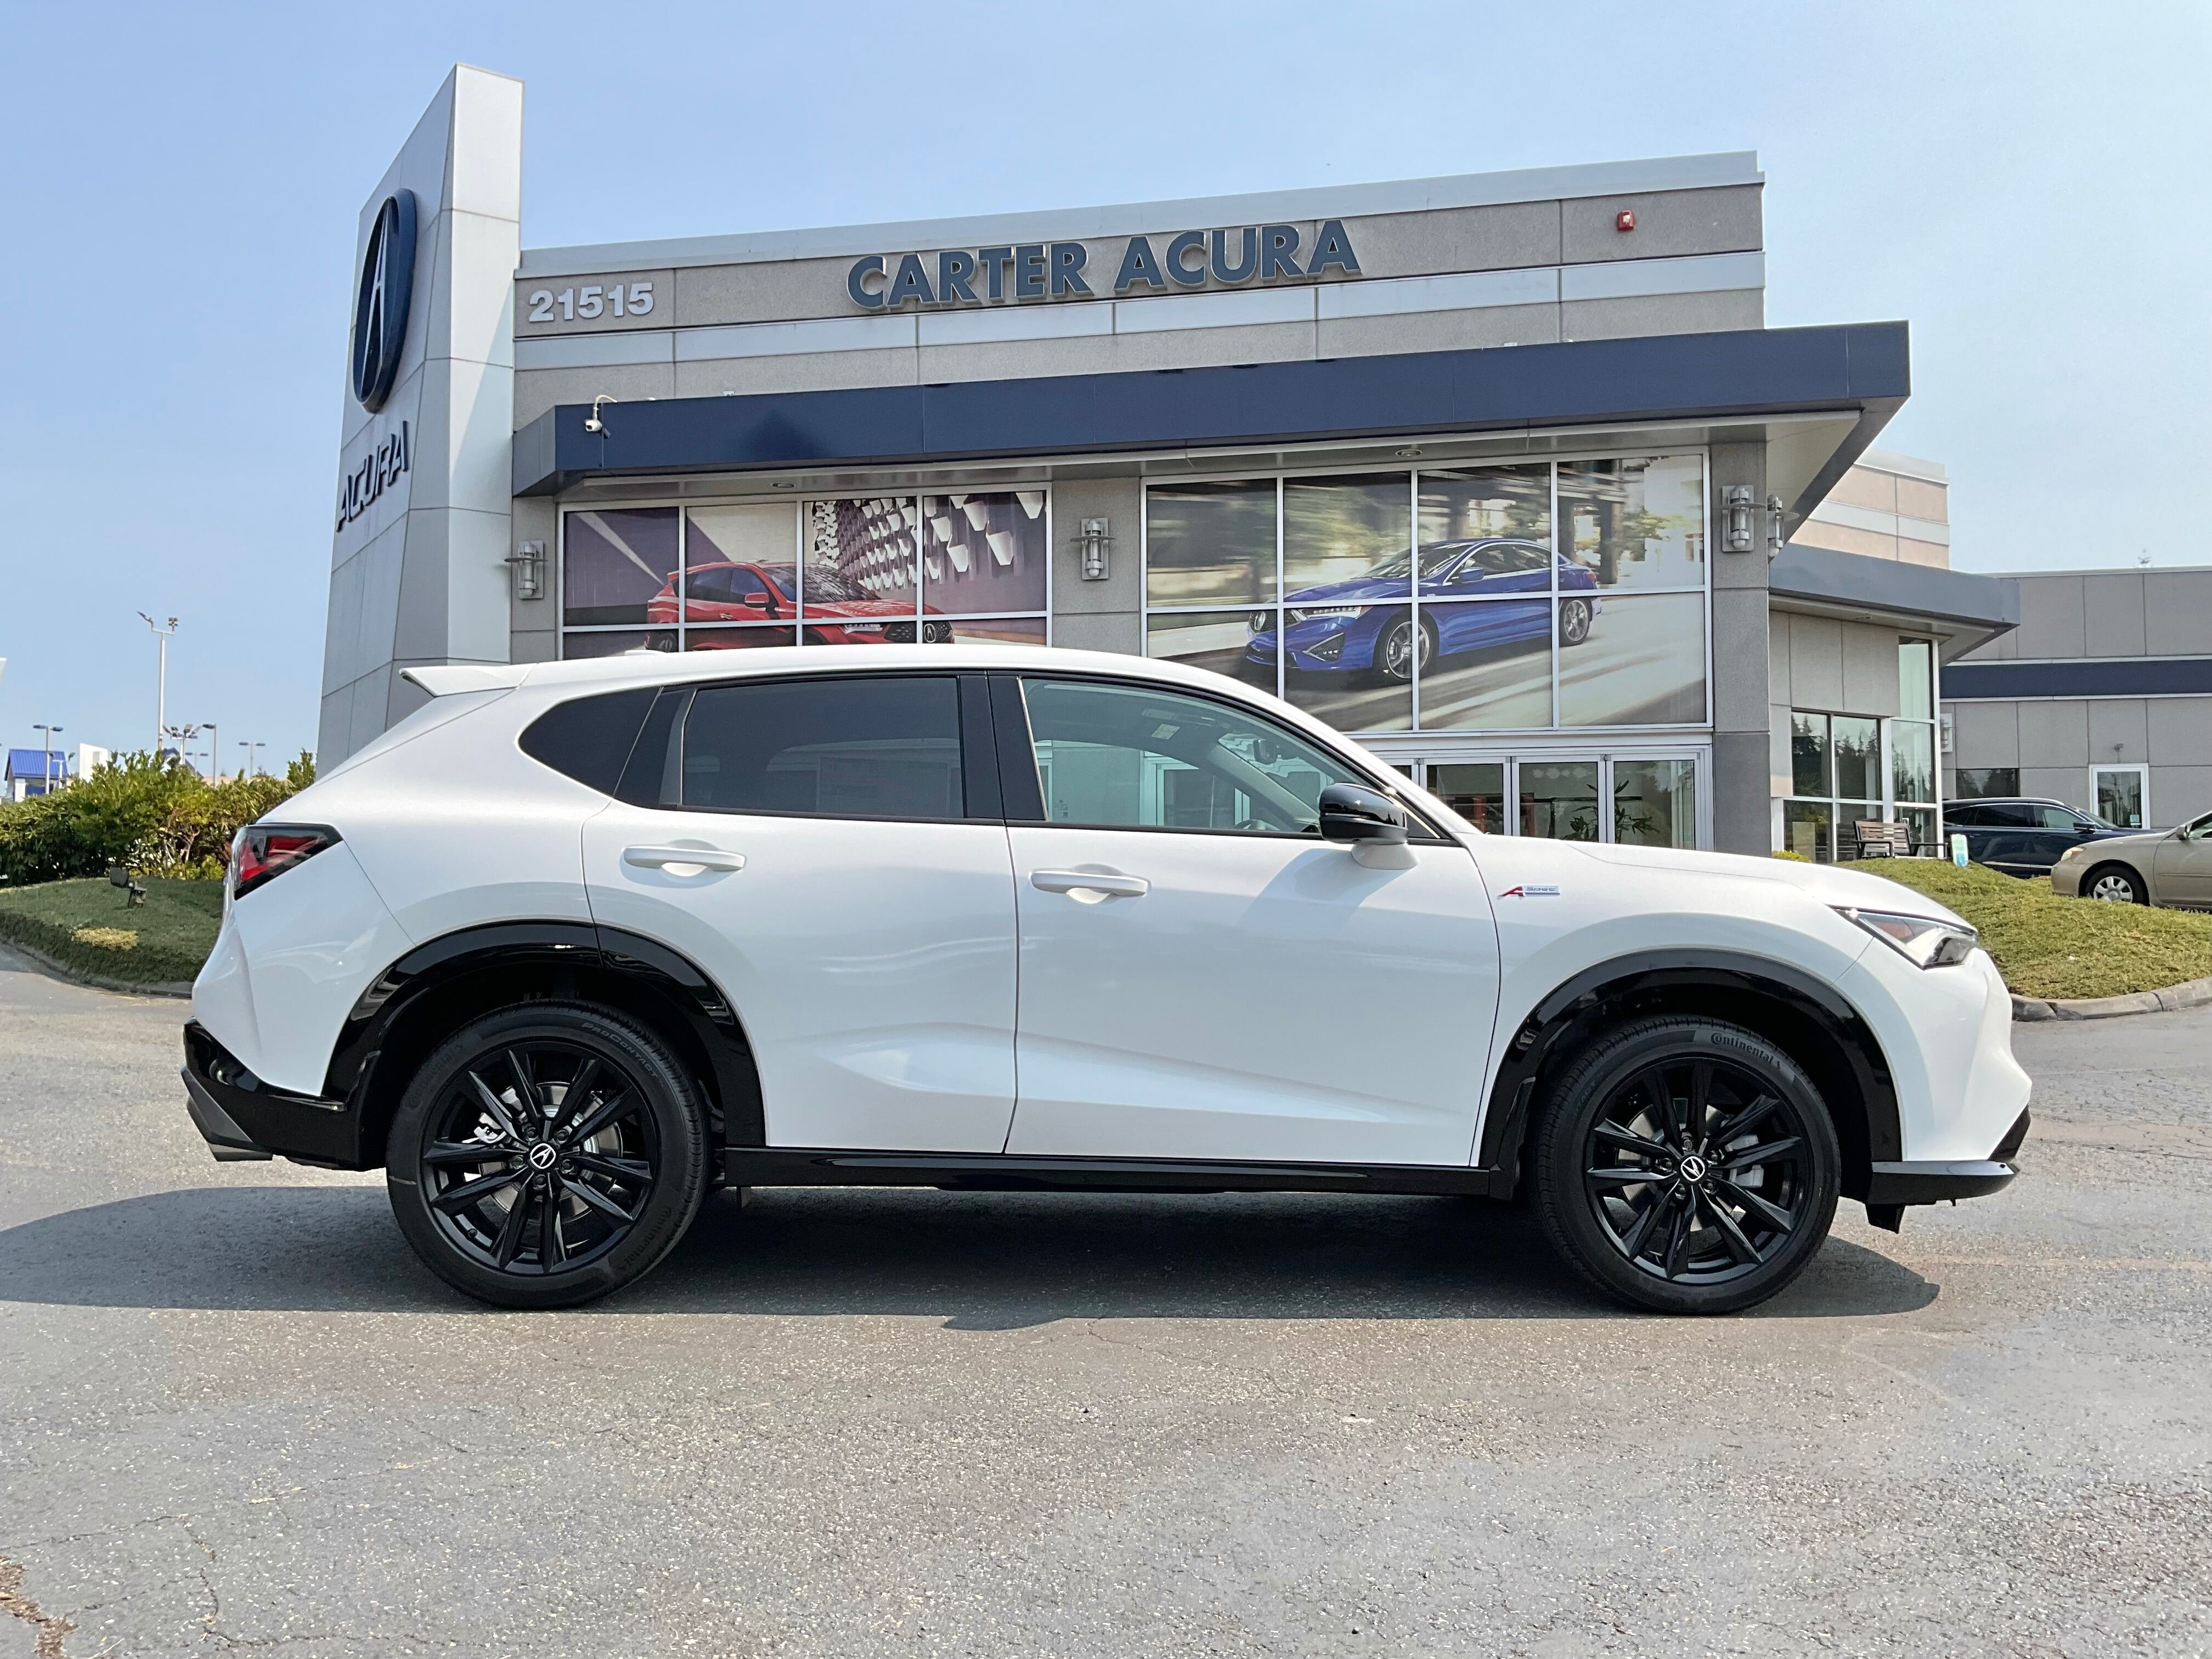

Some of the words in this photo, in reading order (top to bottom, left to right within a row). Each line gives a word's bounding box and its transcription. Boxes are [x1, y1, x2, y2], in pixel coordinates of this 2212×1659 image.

[847, 242, 1094, 311] CARTER
[1114, 219, 1361, 297] ACURA
[529, 282, 654, 323] 21515
[336, 420, 409, 532] ACURA
[1711, 1032, 1774, 1065] Continental
